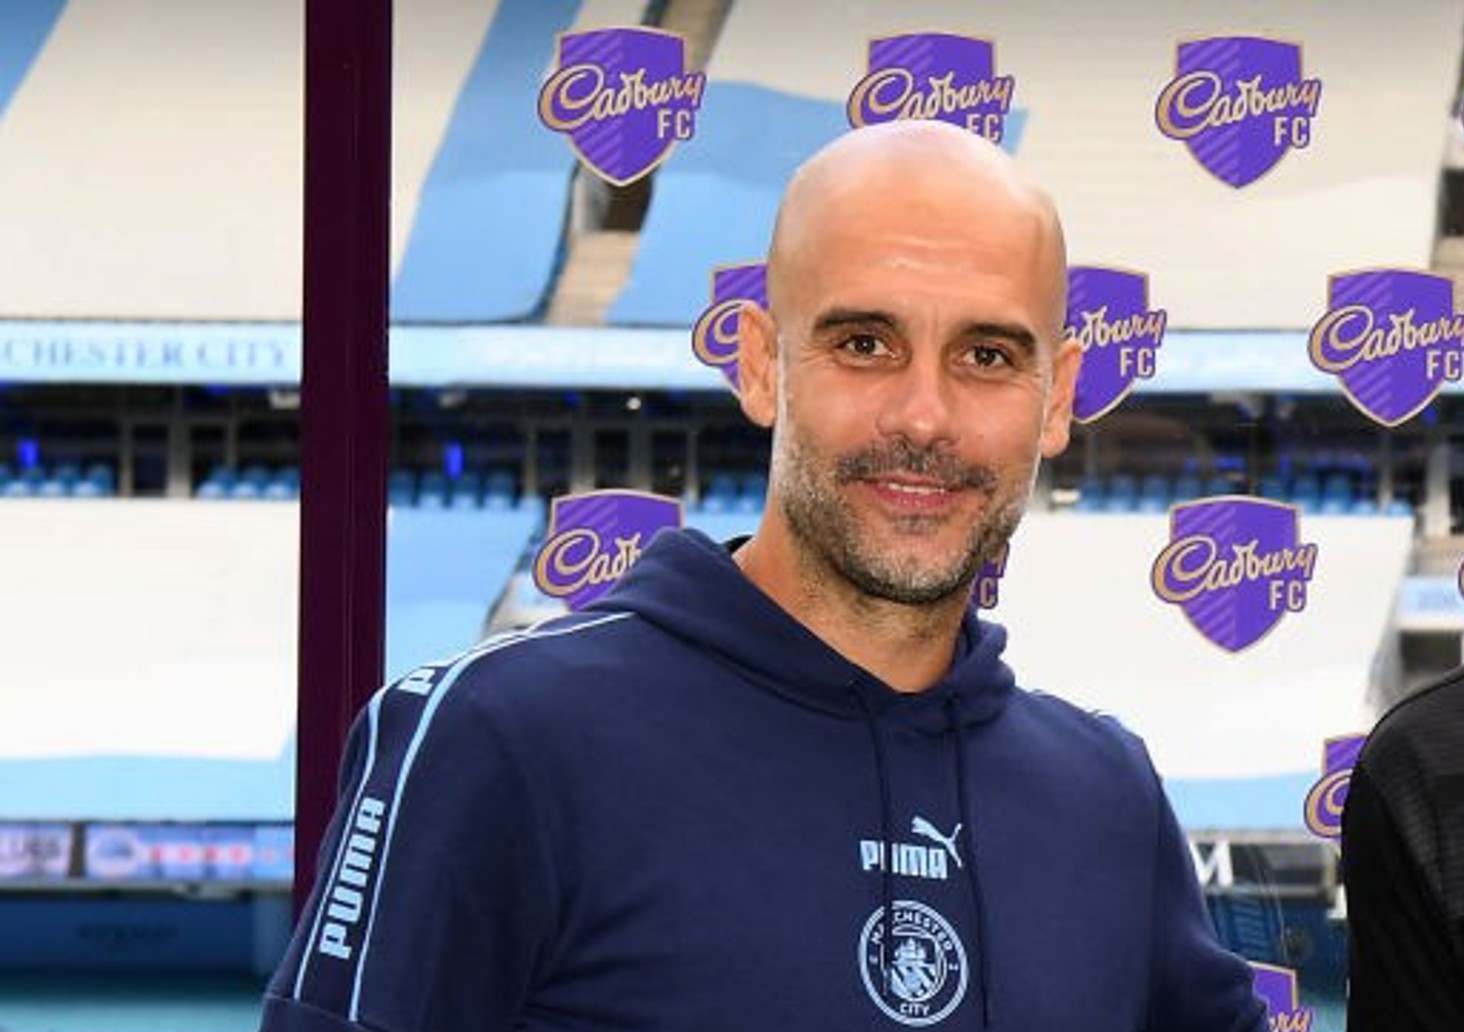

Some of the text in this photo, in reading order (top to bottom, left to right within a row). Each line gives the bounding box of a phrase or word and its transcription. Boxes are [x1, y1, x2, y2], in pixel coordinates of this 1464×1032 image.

[541, 63, 702, 130] Cadbury
[850, 67, 1011, 128] Cadbury
[1158, 70, 1319, 137] Cadbury
[657, 108, 691, 139] FC
[966, 113, 999, 141] FC
[1274, 115, 1308, 146] FC
[1120, 347, 1153, 377] FC
[1427, 349, 1461, 380] FC
[1154, 535, 1315, 602] Cadbury
[1270, 580, 1304, 611] FC
[320, 797, 387, 960] PUMA
[900, 1003, 930, 1016] CITY
